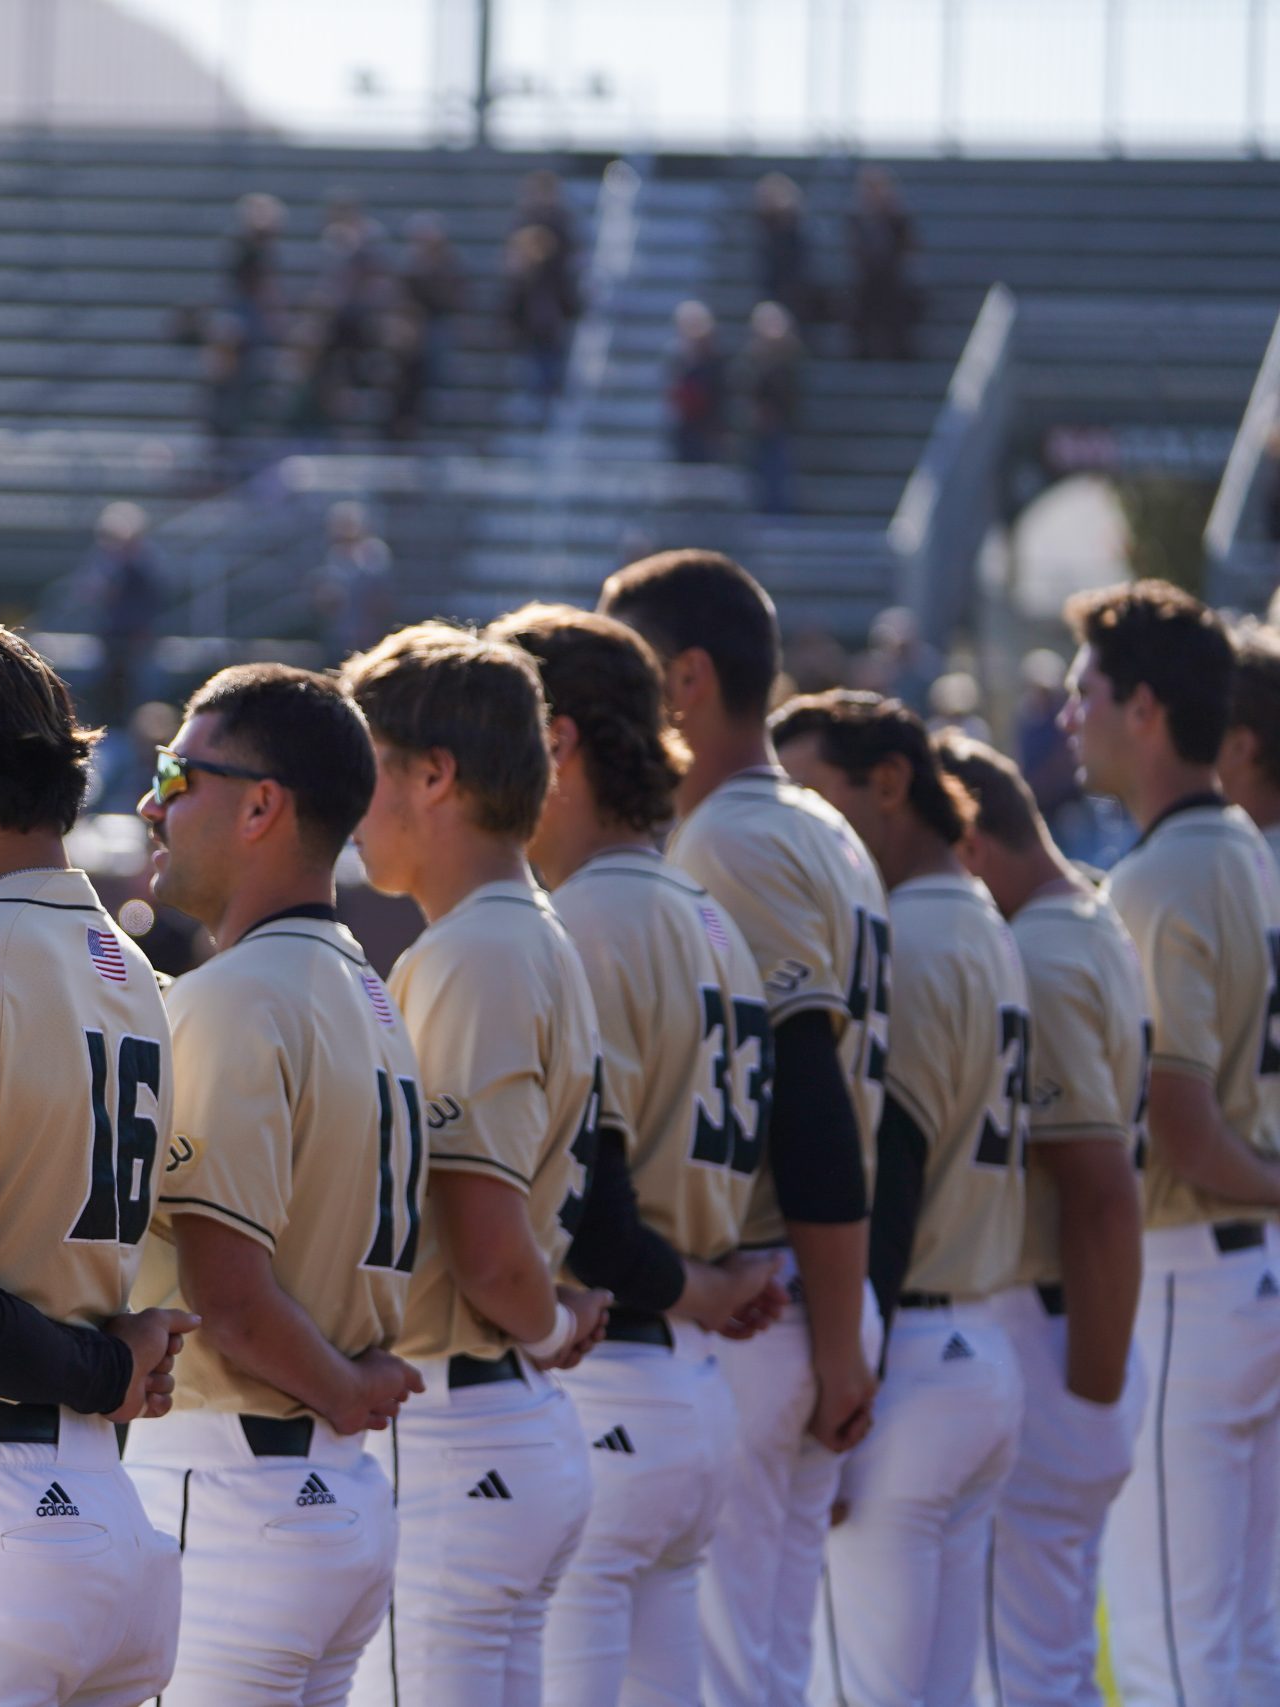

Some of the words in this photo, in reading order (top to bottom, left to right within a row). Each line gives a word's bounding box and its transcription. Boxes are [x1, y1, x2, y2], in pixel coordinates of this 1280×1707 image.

[63, 1026, 161, 1247] 16
[358, 1067, 419, 1275] 11
[686, 982, 774, 1177] 33
[36, 1501, 80, 1517] adidas
[296, 1491, 337, 1507] adidas
